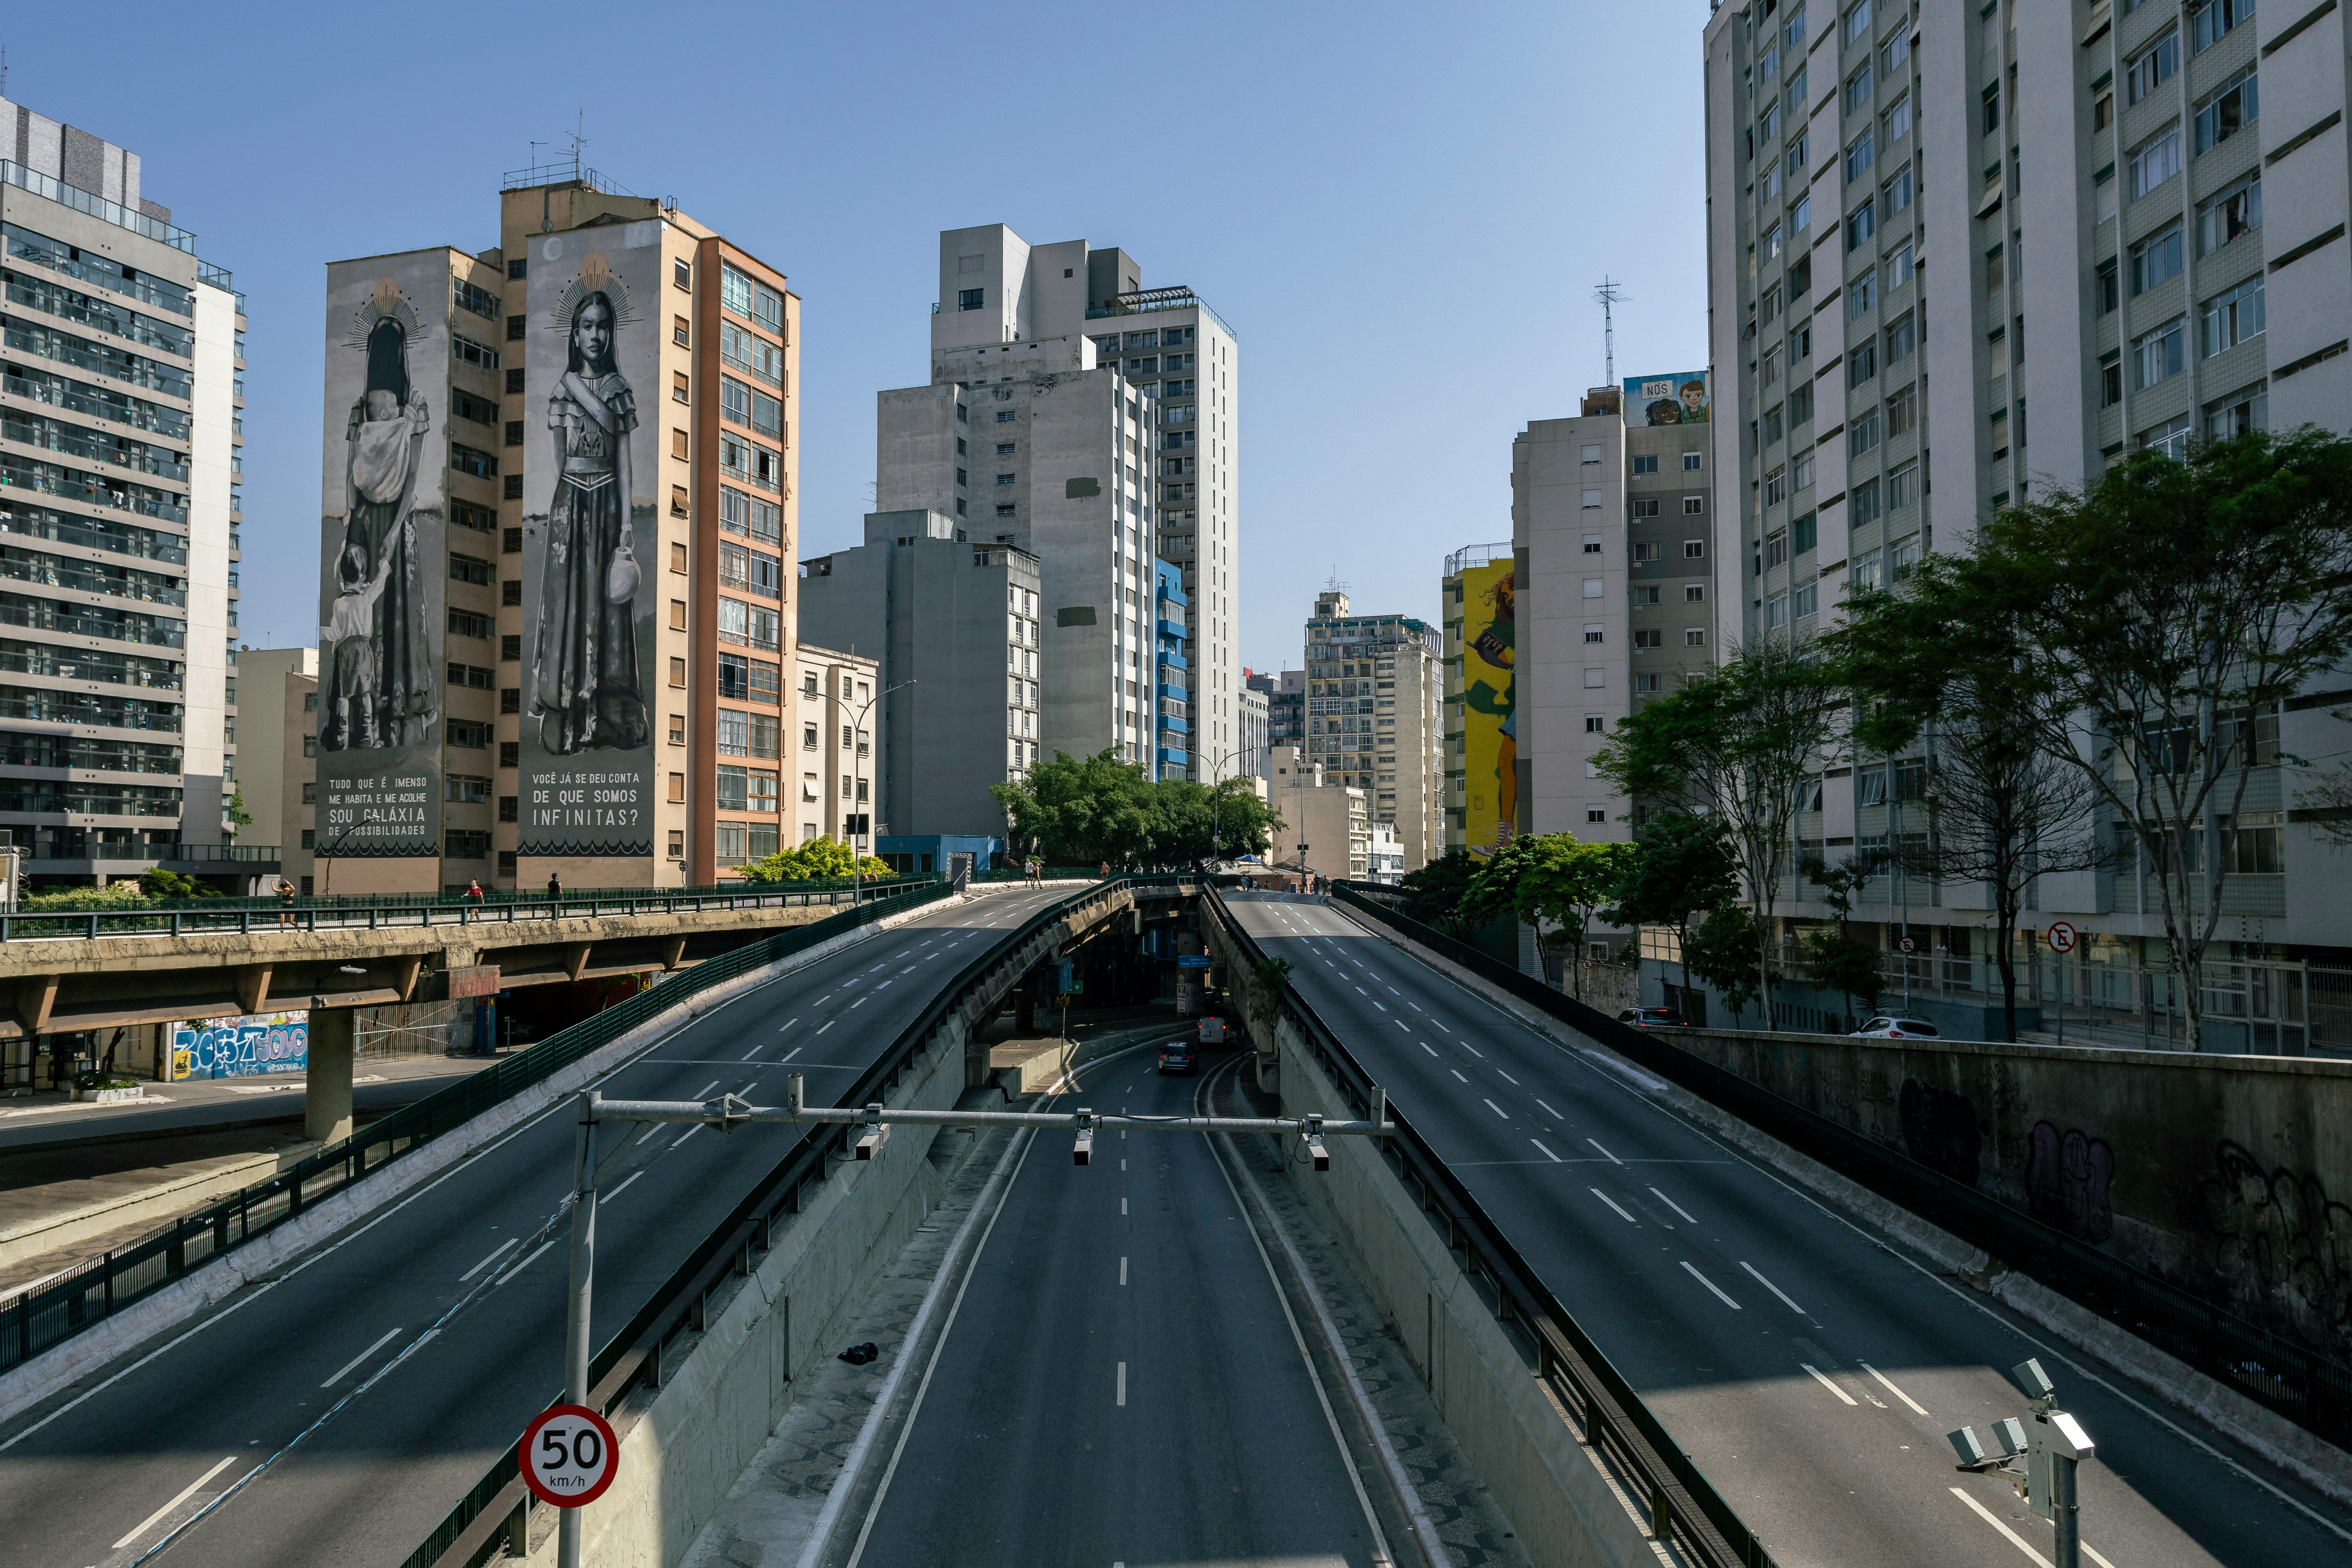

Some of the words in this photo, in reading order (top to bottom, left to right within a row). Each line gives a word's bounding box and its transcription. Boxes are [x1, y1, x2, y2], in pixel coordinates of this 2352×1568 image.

[1647, 382, 1668, 396] NÓS
[1484, 639, 1495, 648] revis,
[1491, 644, 1503, 653] onga
[330, 779, 350, 789] TUDO
[358, 779, 374, 789] QUE
[381, 776, 387, 787] É
[395, 777, 426, 787] IMENSO
[533, 772, 556, 784] VOCÊ
[559, 772, 571, 784] JÁ
[576, 774, 586, 784] SE
[589, 774, 606, 783] DEU
[609, 773, 640, 783] CONTA
[329, 795, 341, 804] ME
[345, 795, 373, 804] HABITA
[377, 794, 381, 803] E
[385, 793, 396, 803] ME
[399, 793, 426, 802] ACOLHE
[533, 790, 549, 803] DE
[559, 790, 584, 805] QUE
[594, 789, 637, 802] SOMOS
[330, 809, 353, 823] SOU
[364, 806, 425, 822] GALÁXIA
[533, 809, 638, 826] INFINITAS?
[329, 827, 340, 836] DE
[350, 826, 425, 836] POSSIBILIDADES
[542, 1429, 601, 1469] 50
[550, 1475, 585, 1487] km/h
